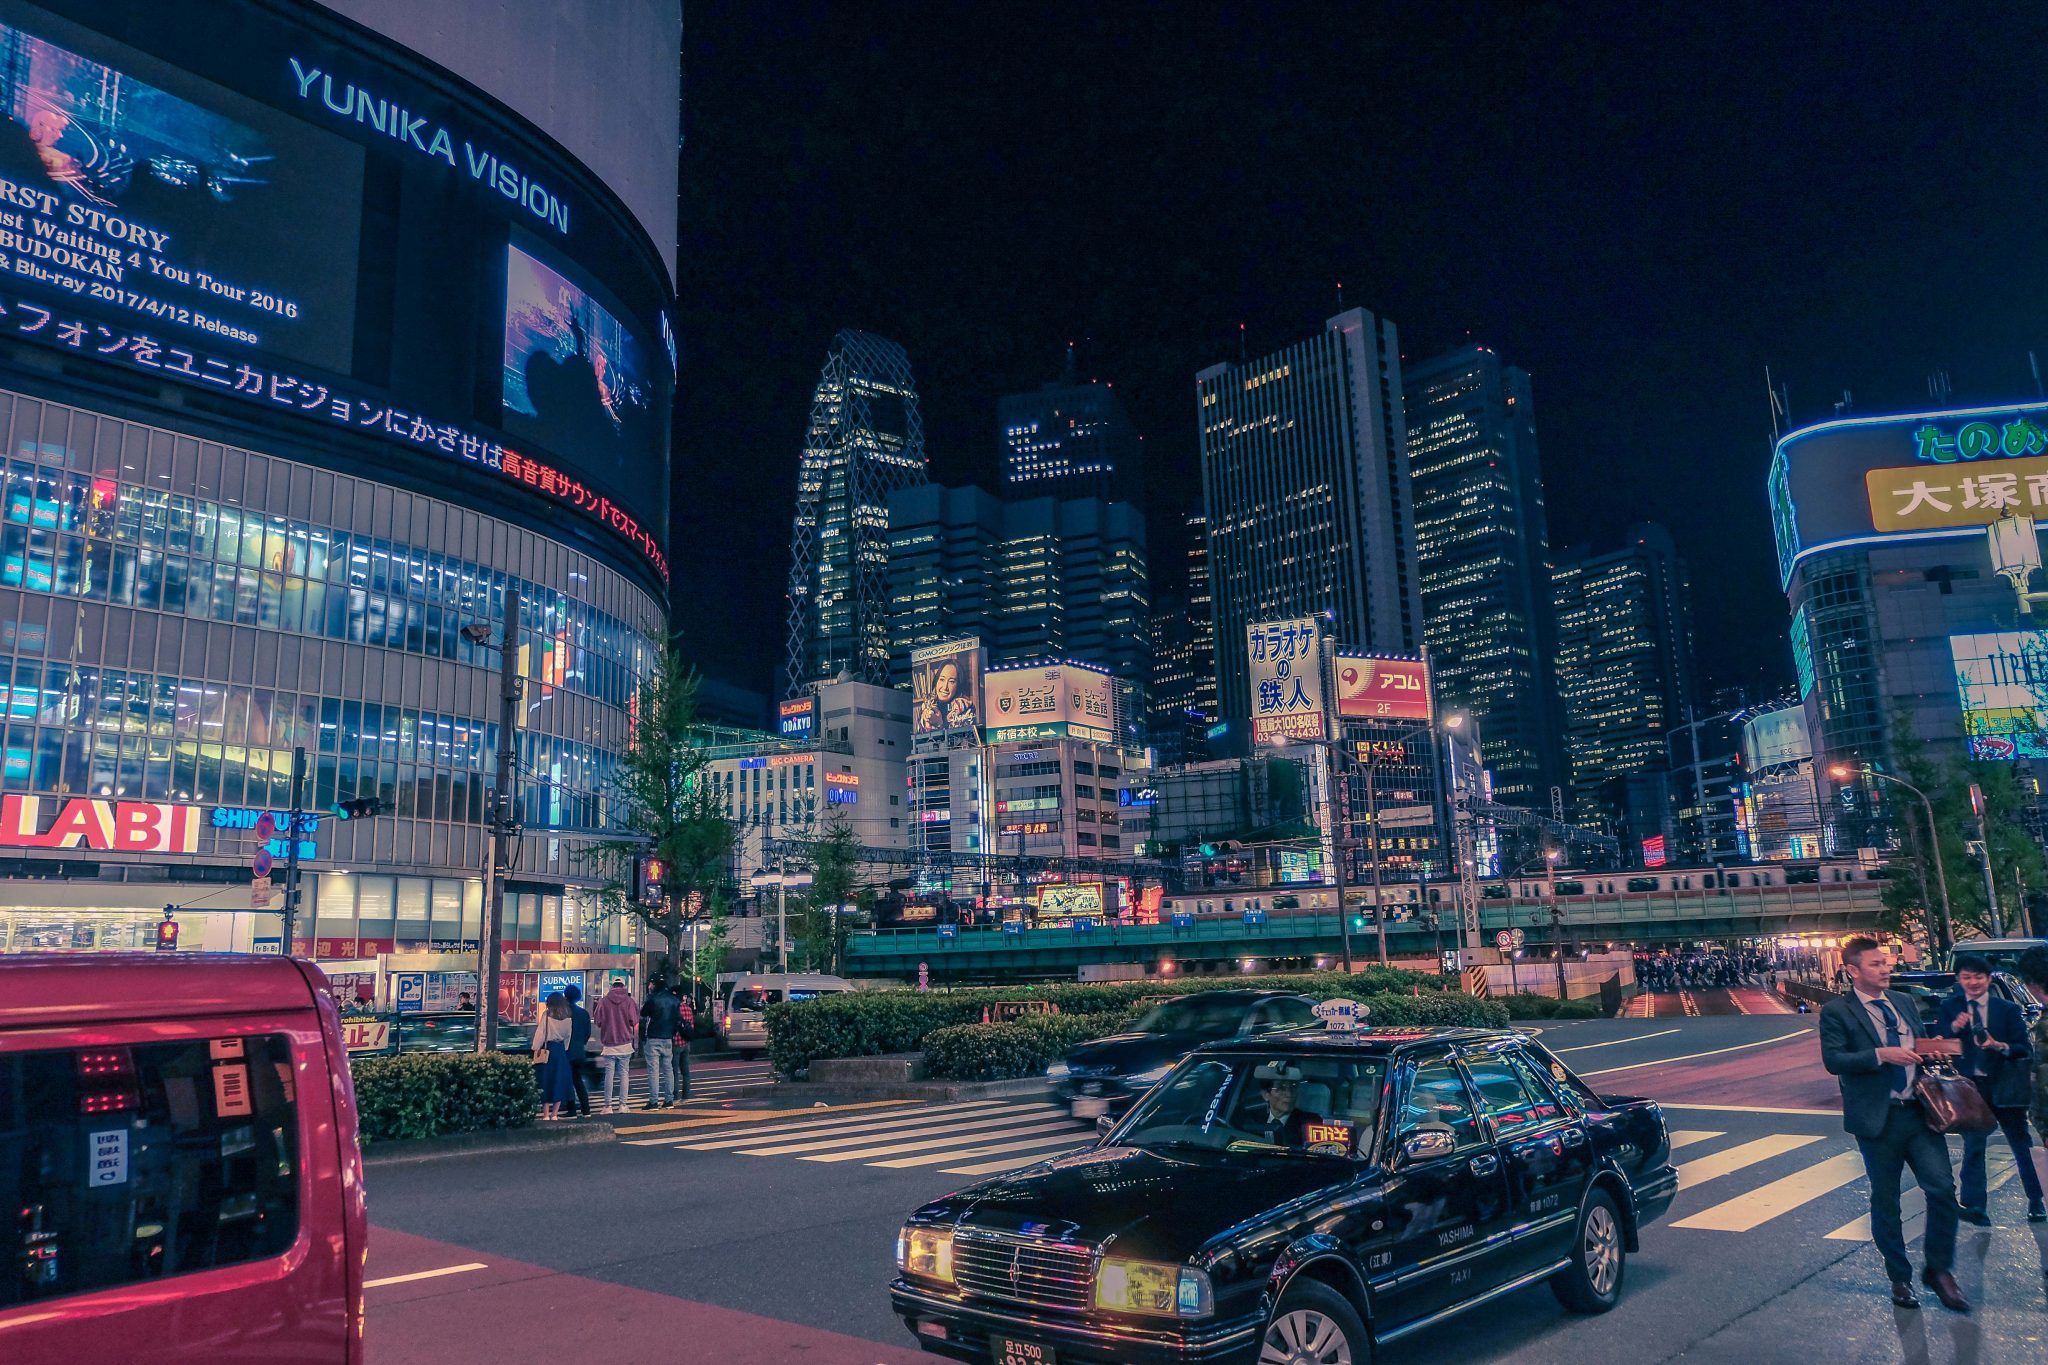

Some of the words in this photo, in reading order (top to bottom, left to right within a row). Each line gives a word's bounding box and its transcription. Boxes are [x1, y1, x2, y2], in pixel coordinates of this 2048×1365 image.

[290, 57, 456, 166] YUNIKA
[465, 142, 568, 235] VISION
[67, 204, 170, 253] STORY
[0, 229, 124, 283] BUDOKAN
[32, 218, 121, 265] Waiting
[127, 252, 141, 268] 4
[149, 257, 190, 285] You
[196, 273, 245, 302] Tour
[250, 291, 298, 319] 2016
[16, 258, 86, 293] Blu-ray
[90, 282, 189, 325] 2017/4/12
[194, 314, 258, 345] Release
[1914, 418, 2048, 463] たのめ
[1250, 622, 1314, 664] カラオケ
[1275, 656, 1293, 680] の
[1018, 684, 1056, 698] シェーン
[1379, 673, 1421, 691] アコム
[1019, 695, 1056, 711] 英会話
[1257, 676, 1314, 714] 鉄人
[1377, 703, 1391, 714] 2F
[783, 716, 811, 733] ODAKYU
[996, 726, 1038, 740] 新宿本校
[1257, 727, 1320, 742] 03-45-6430
[784, 755, 815, 765] CAMERA
[829, 788, 857, 804] ODAKYU
[0, 794, 200, 852] LABI
[543, 975, 581, 986] SUBNADE
[400, 981, 412, 999] P
[341, 1015, 378, 1024] rohibited.
[1330, 1022, 1345, 1030] 1072
[1308, 1124, 1349, 1143] 回送
[1438, 1224, 1475, 1247] YASHIMA
[1450, 1268, 1472, 1285] TAXI
